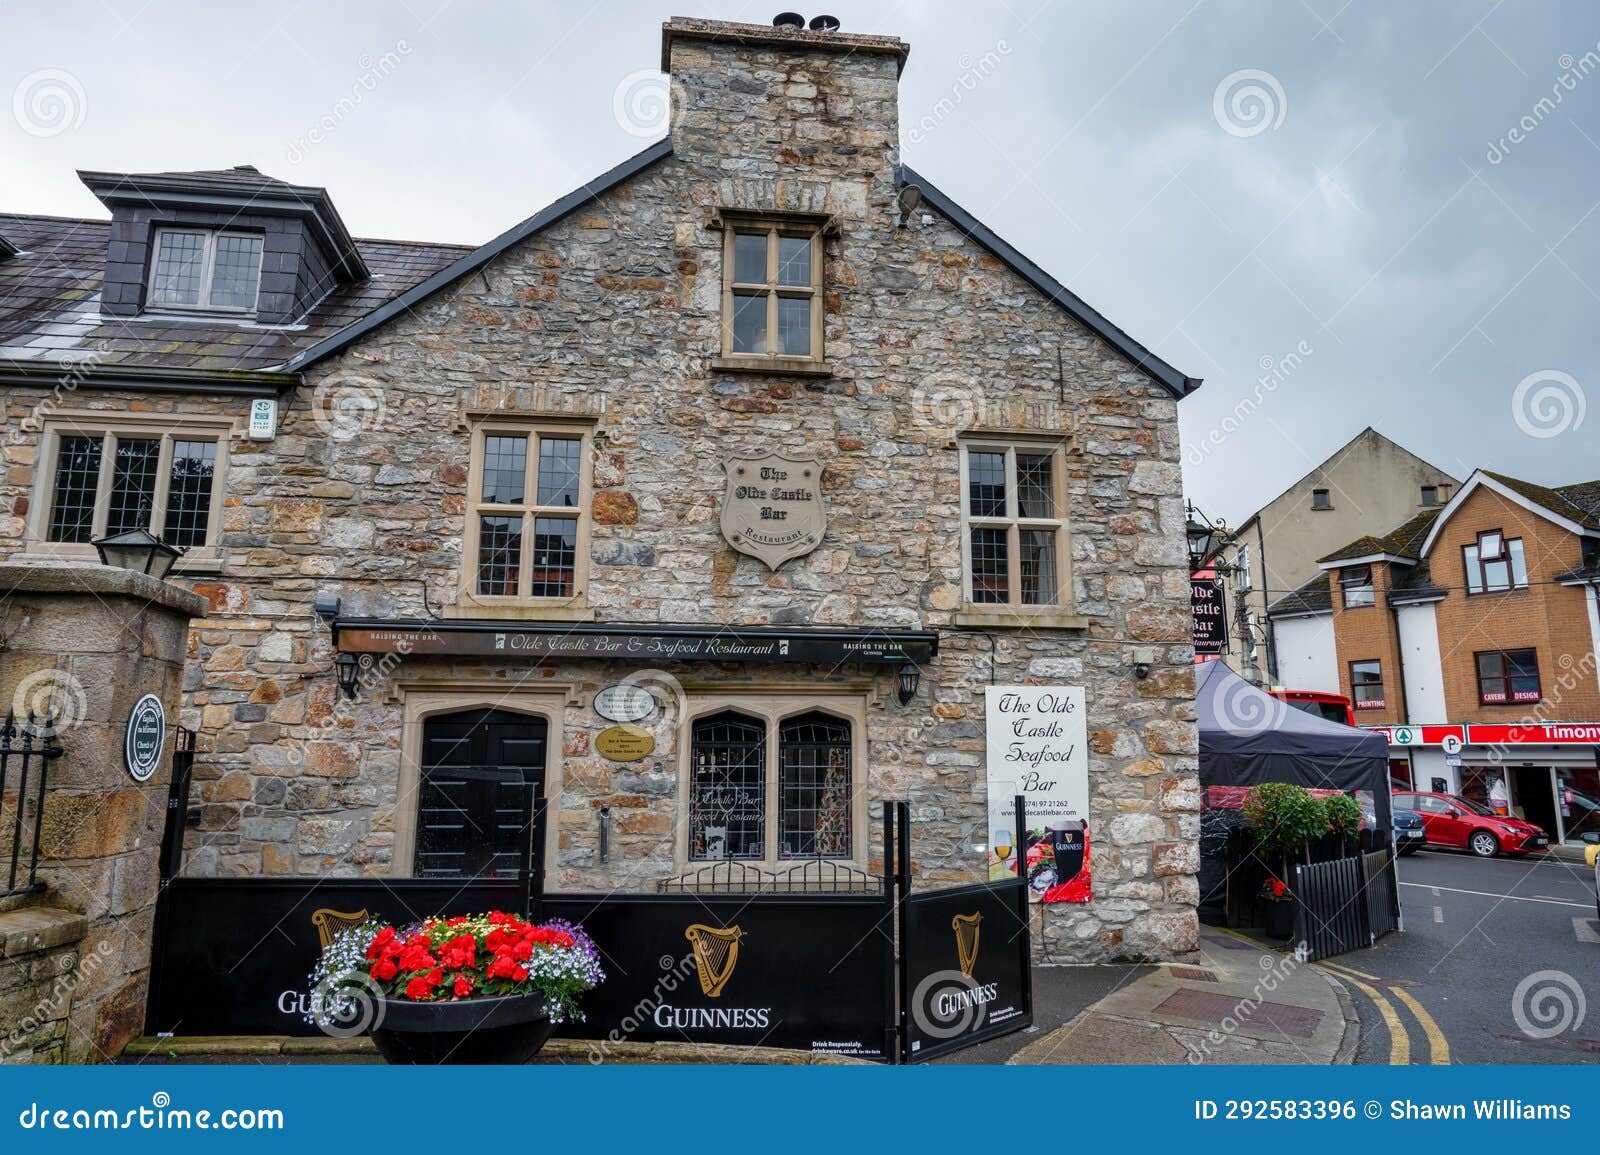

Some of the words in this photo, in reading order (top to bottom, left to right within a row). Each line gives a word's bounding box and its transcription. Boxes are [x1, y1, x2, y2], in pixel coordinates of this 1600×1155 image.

[760, 467, 788, 482] The
[735, 486, 767, 499] Olde
[771, 487, 813, 501] Castle
[760, 507, 787, 520] Bar
[745, 527, 802, 542] Restaurant
[370, 632, 400, 640] RAISING
[511, 634, 542, 649] Olde
[548, 634, 589, 650] Castle
[593, 636, 622, 651] Bar
[627, 635, 642, 651] &
[646, 637, 702, 656] Seafood
[706, 637, 774, 656] Restaurant
[999, 693, 1031, 713] The
[1037, 693, 1075, 713] Olde
[1484, 693, 1507, 701] CAVERN
[1514, 691, 1539, 700] DESIGN
[1356, 700, 1386, 708] PRINTING
[1012, 718, 1064, 738] Castle
[1448, 738, 1456, 750] P
[1005, 742, 1075, 768] Seafood
[1021, 771, 1057, 791] Bar
[939, 983, 997, 1016] GUINNESS
[654, 1004, 770, 1028] GUINNESS
